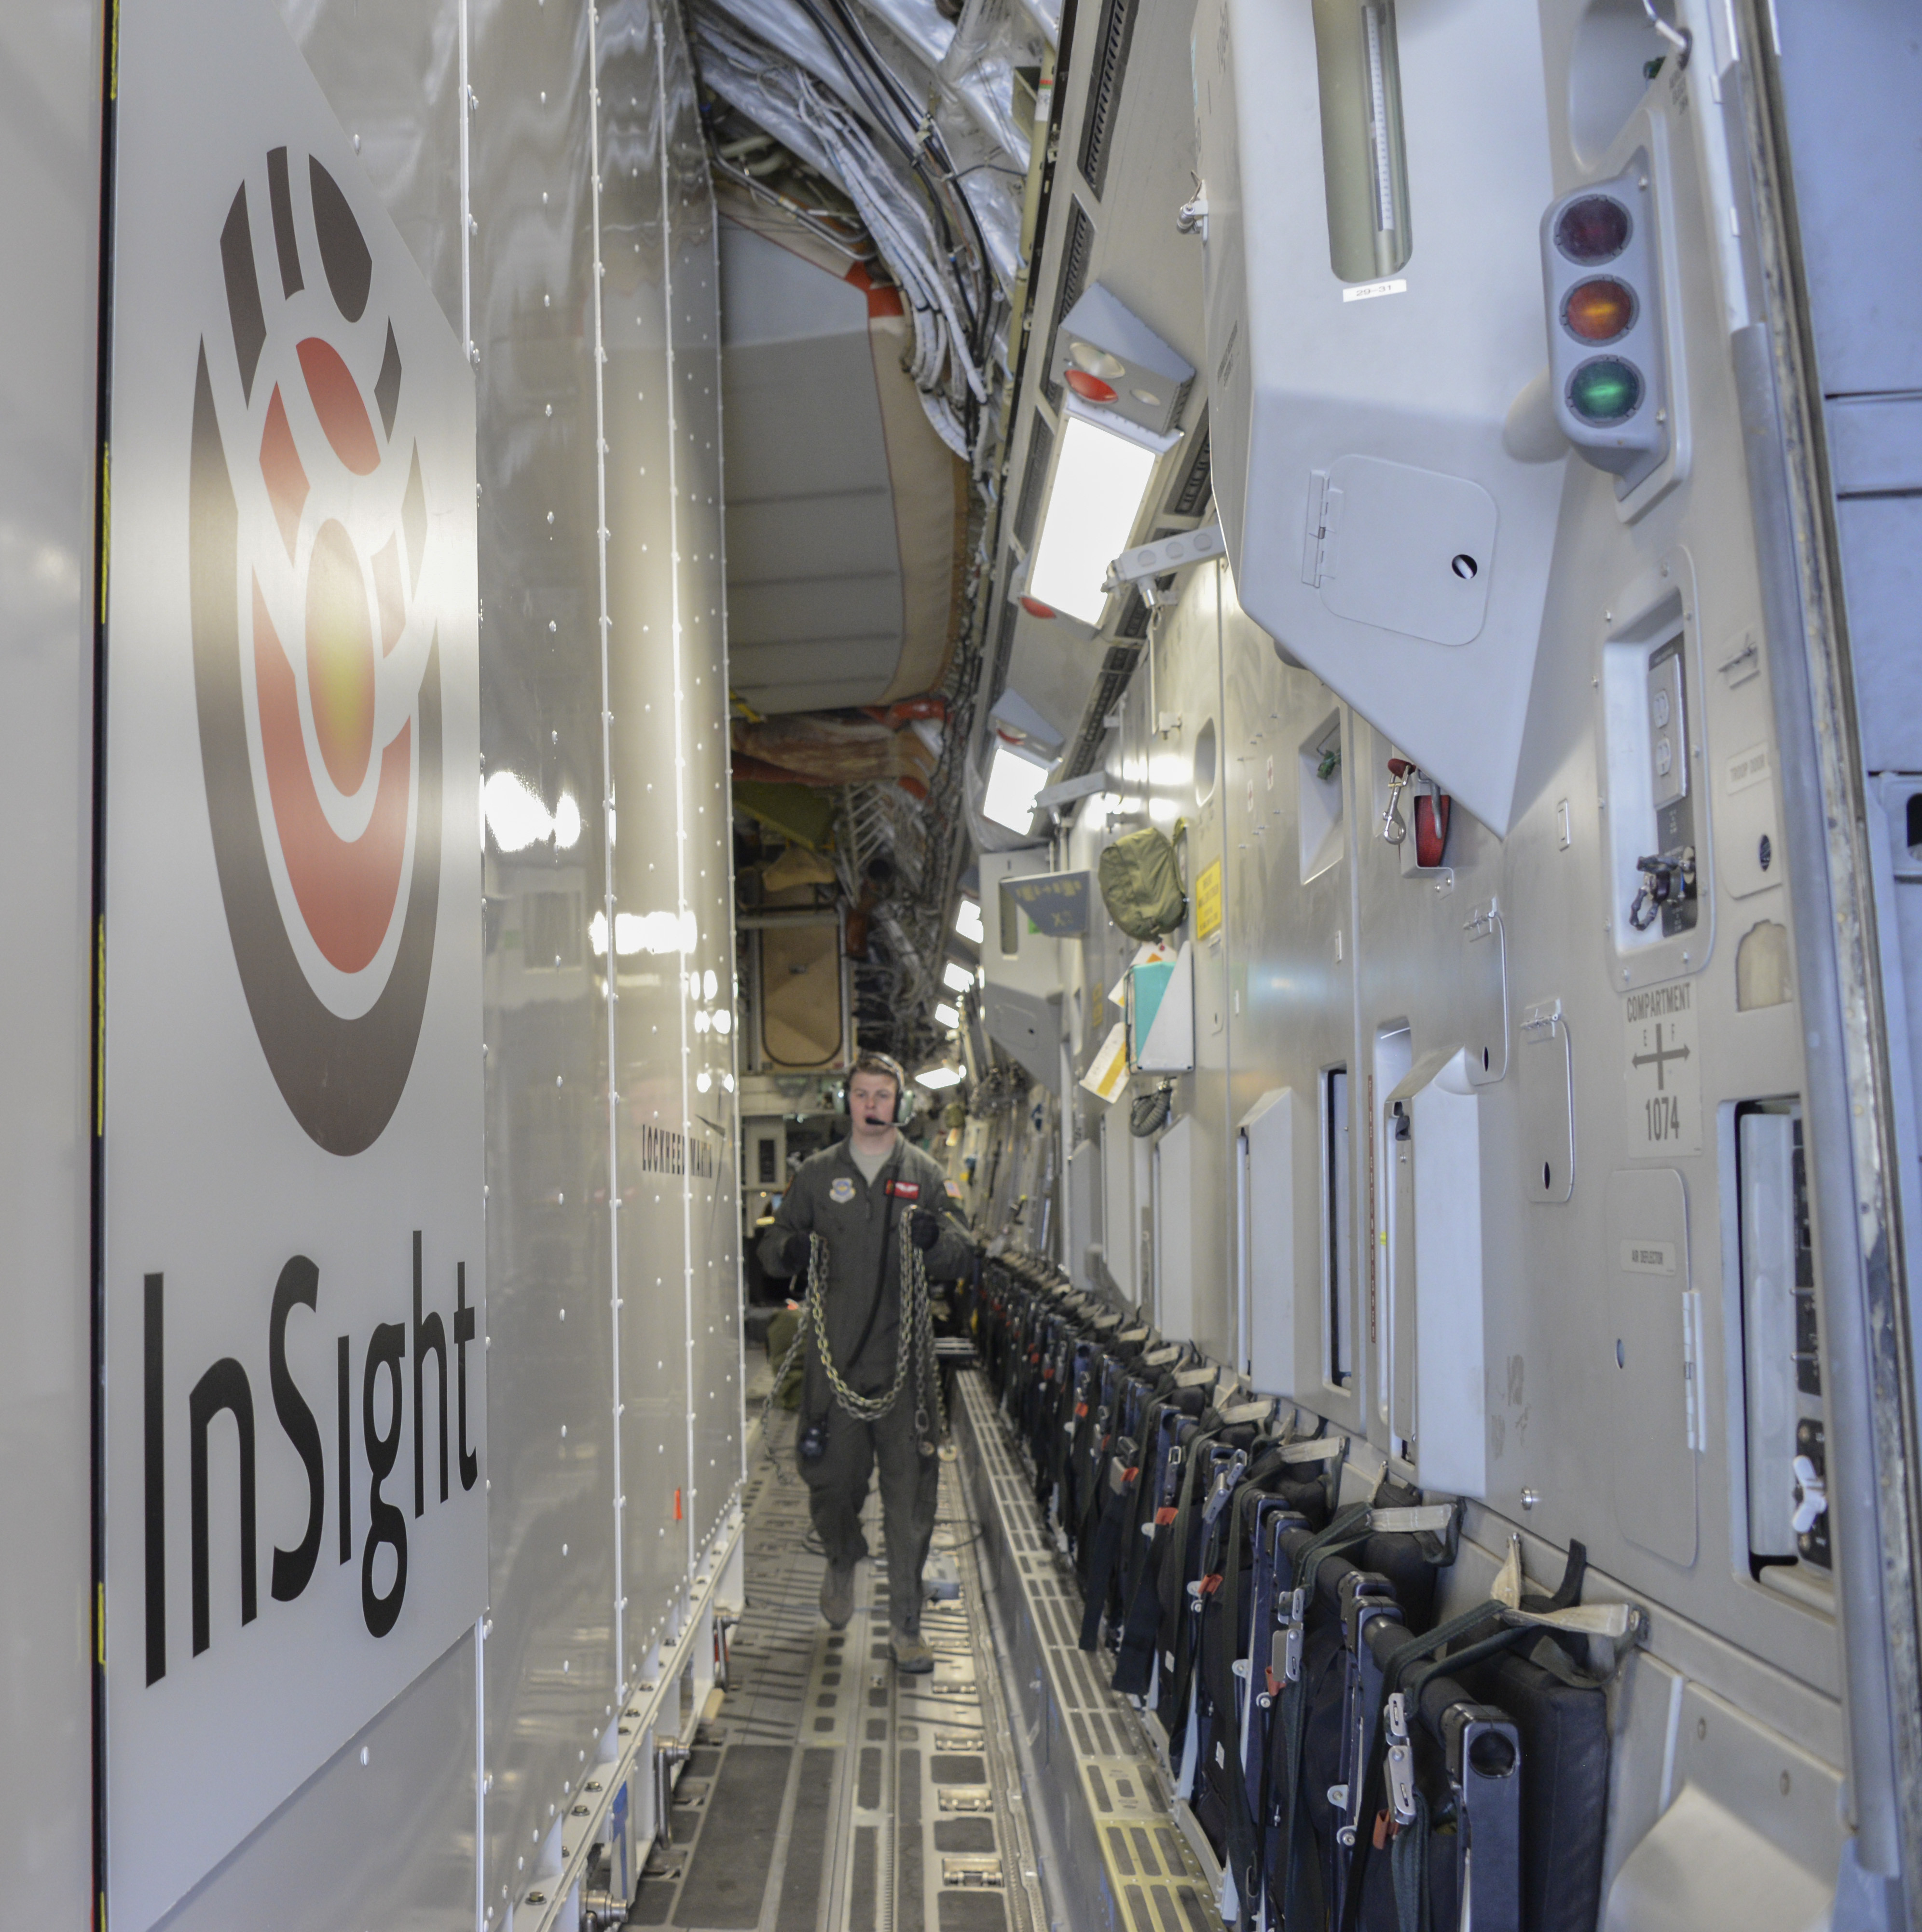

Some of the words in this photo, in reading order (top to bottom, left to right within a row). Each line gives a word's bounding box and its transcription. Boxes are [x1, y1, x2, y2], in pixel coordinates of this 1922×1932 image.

[1356, 285, 1392, 296] 29-31
[1627, 982, 1690, 1023] COMPARTMENT
[1646, 1095, 1680, 1141] 1074
[144, 1230, 478, 1689] InSight
